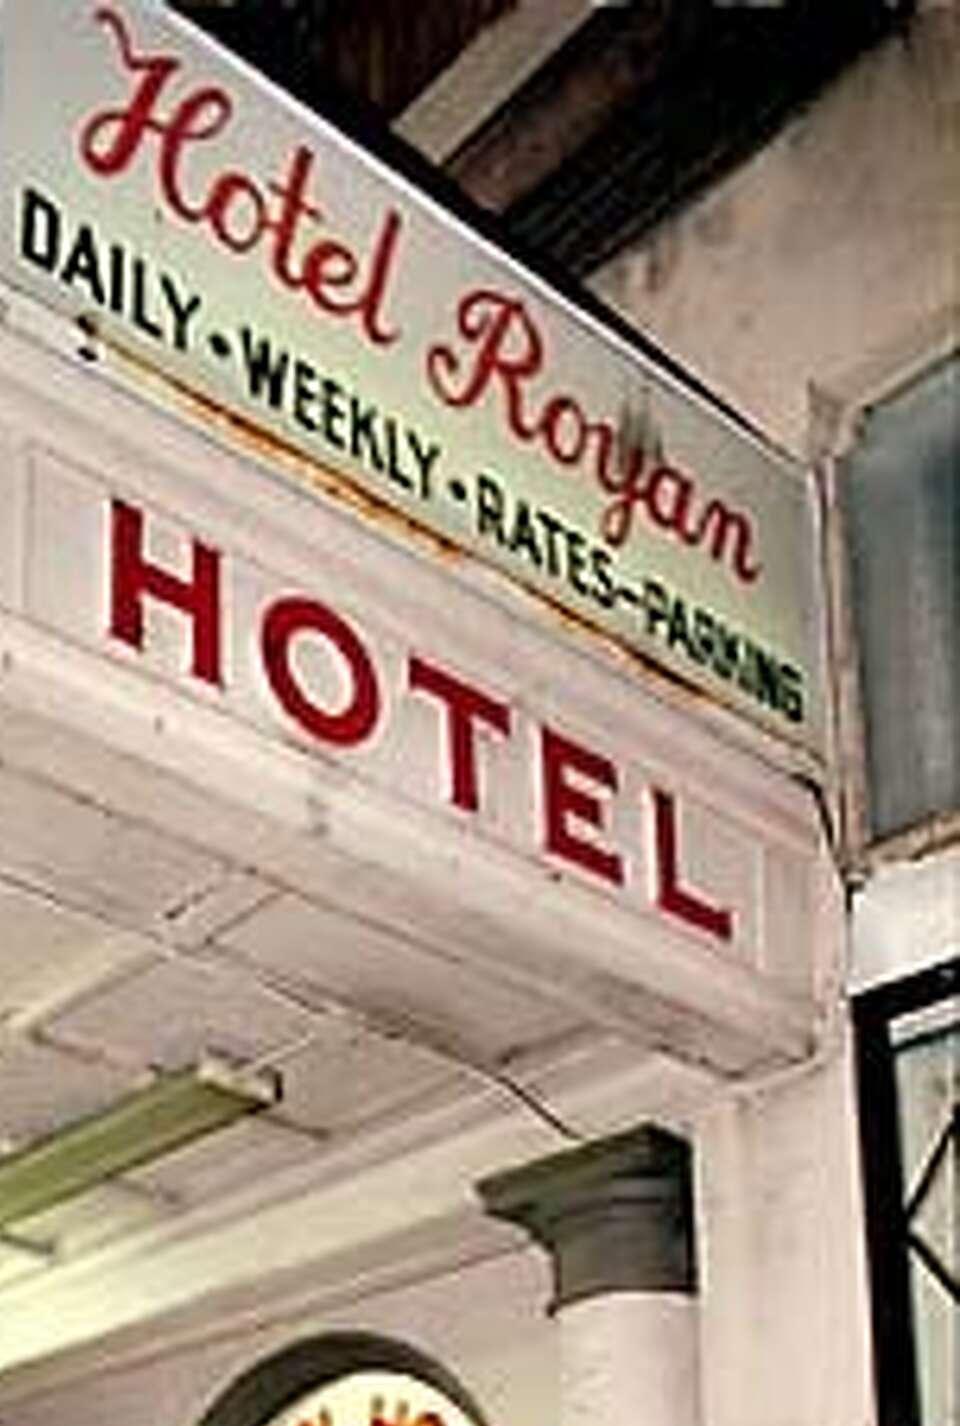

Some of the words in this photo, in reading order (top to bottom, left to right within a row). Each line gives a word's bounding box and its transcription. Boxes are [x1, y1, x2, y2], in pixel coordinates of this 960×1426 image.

[22, 187, 201, 352] DAILY
[241, 326, 439, 501] WEEKLY
[81, 8, 398, 344] Hotel
[427, 290, 762, 583] Royan
[109, 499, 733, 942] HOTEL
